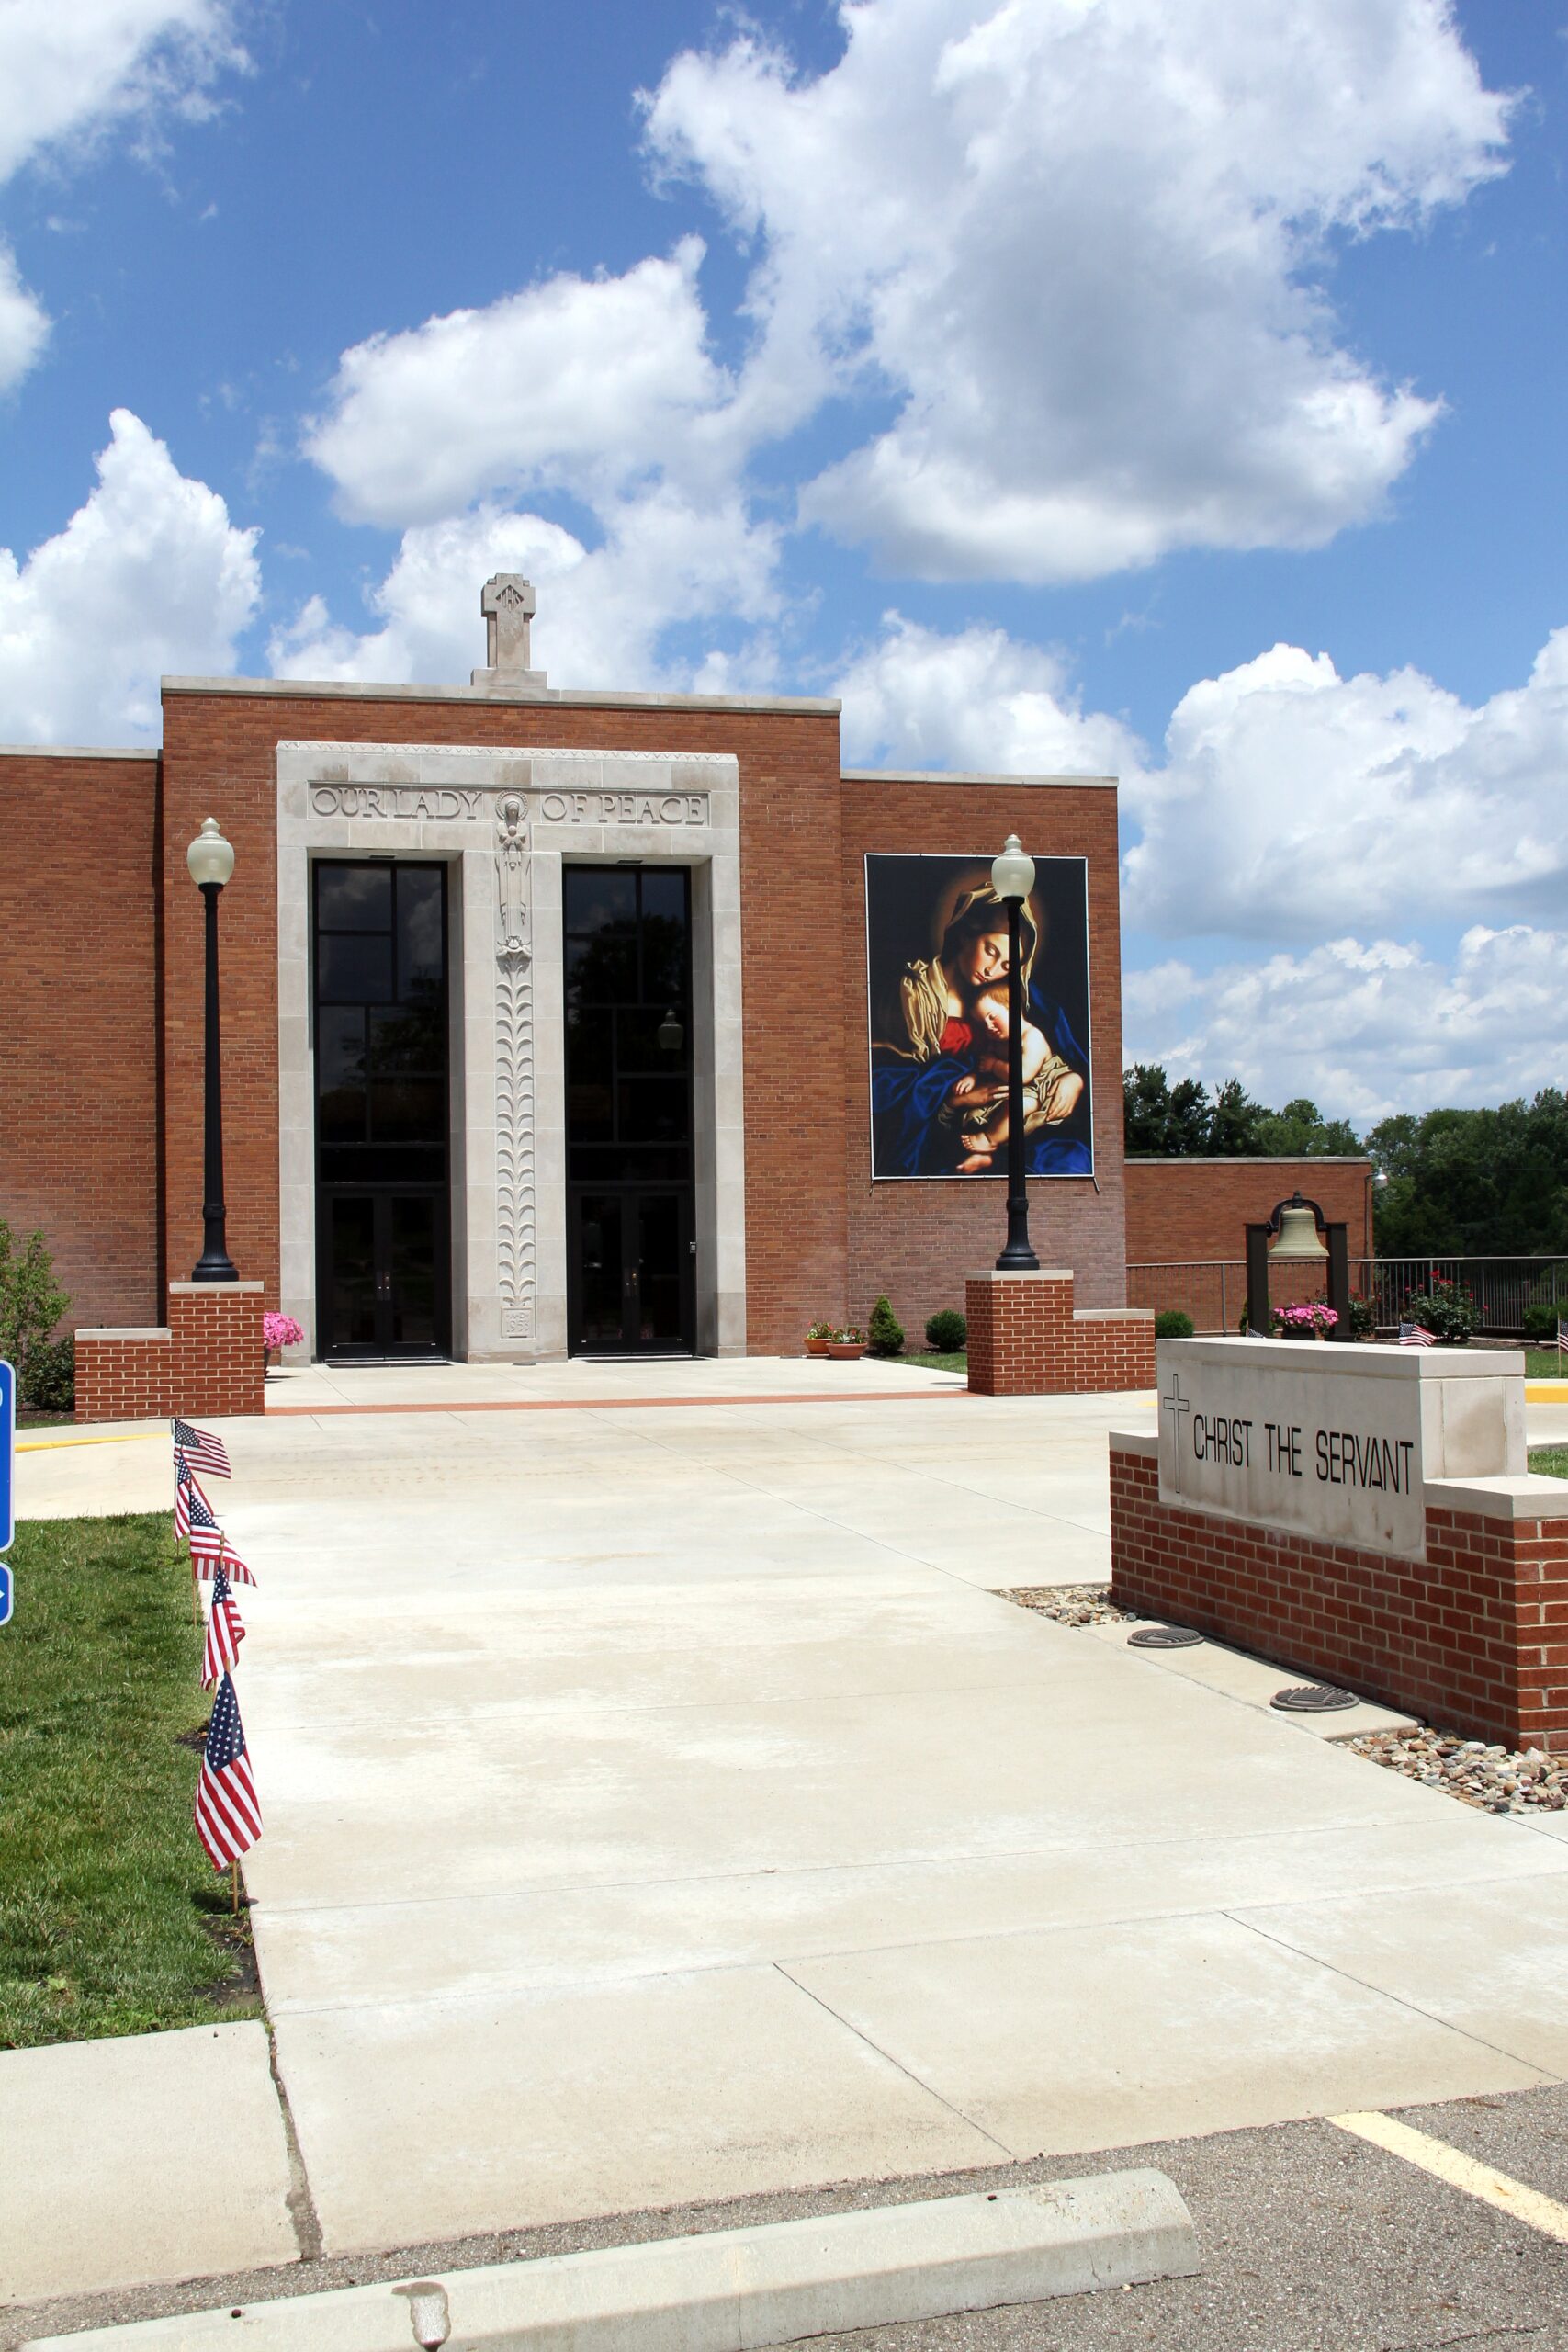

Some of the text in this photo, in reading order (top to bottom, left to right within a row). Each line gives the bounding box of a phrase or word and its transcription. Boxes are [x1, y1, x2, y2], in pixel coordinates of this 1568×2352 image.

[312, 787, 705, 825] OUR LADY OF PEACE
[1194, 1414, 1414, 1495] CHRIST THE SERVANT
